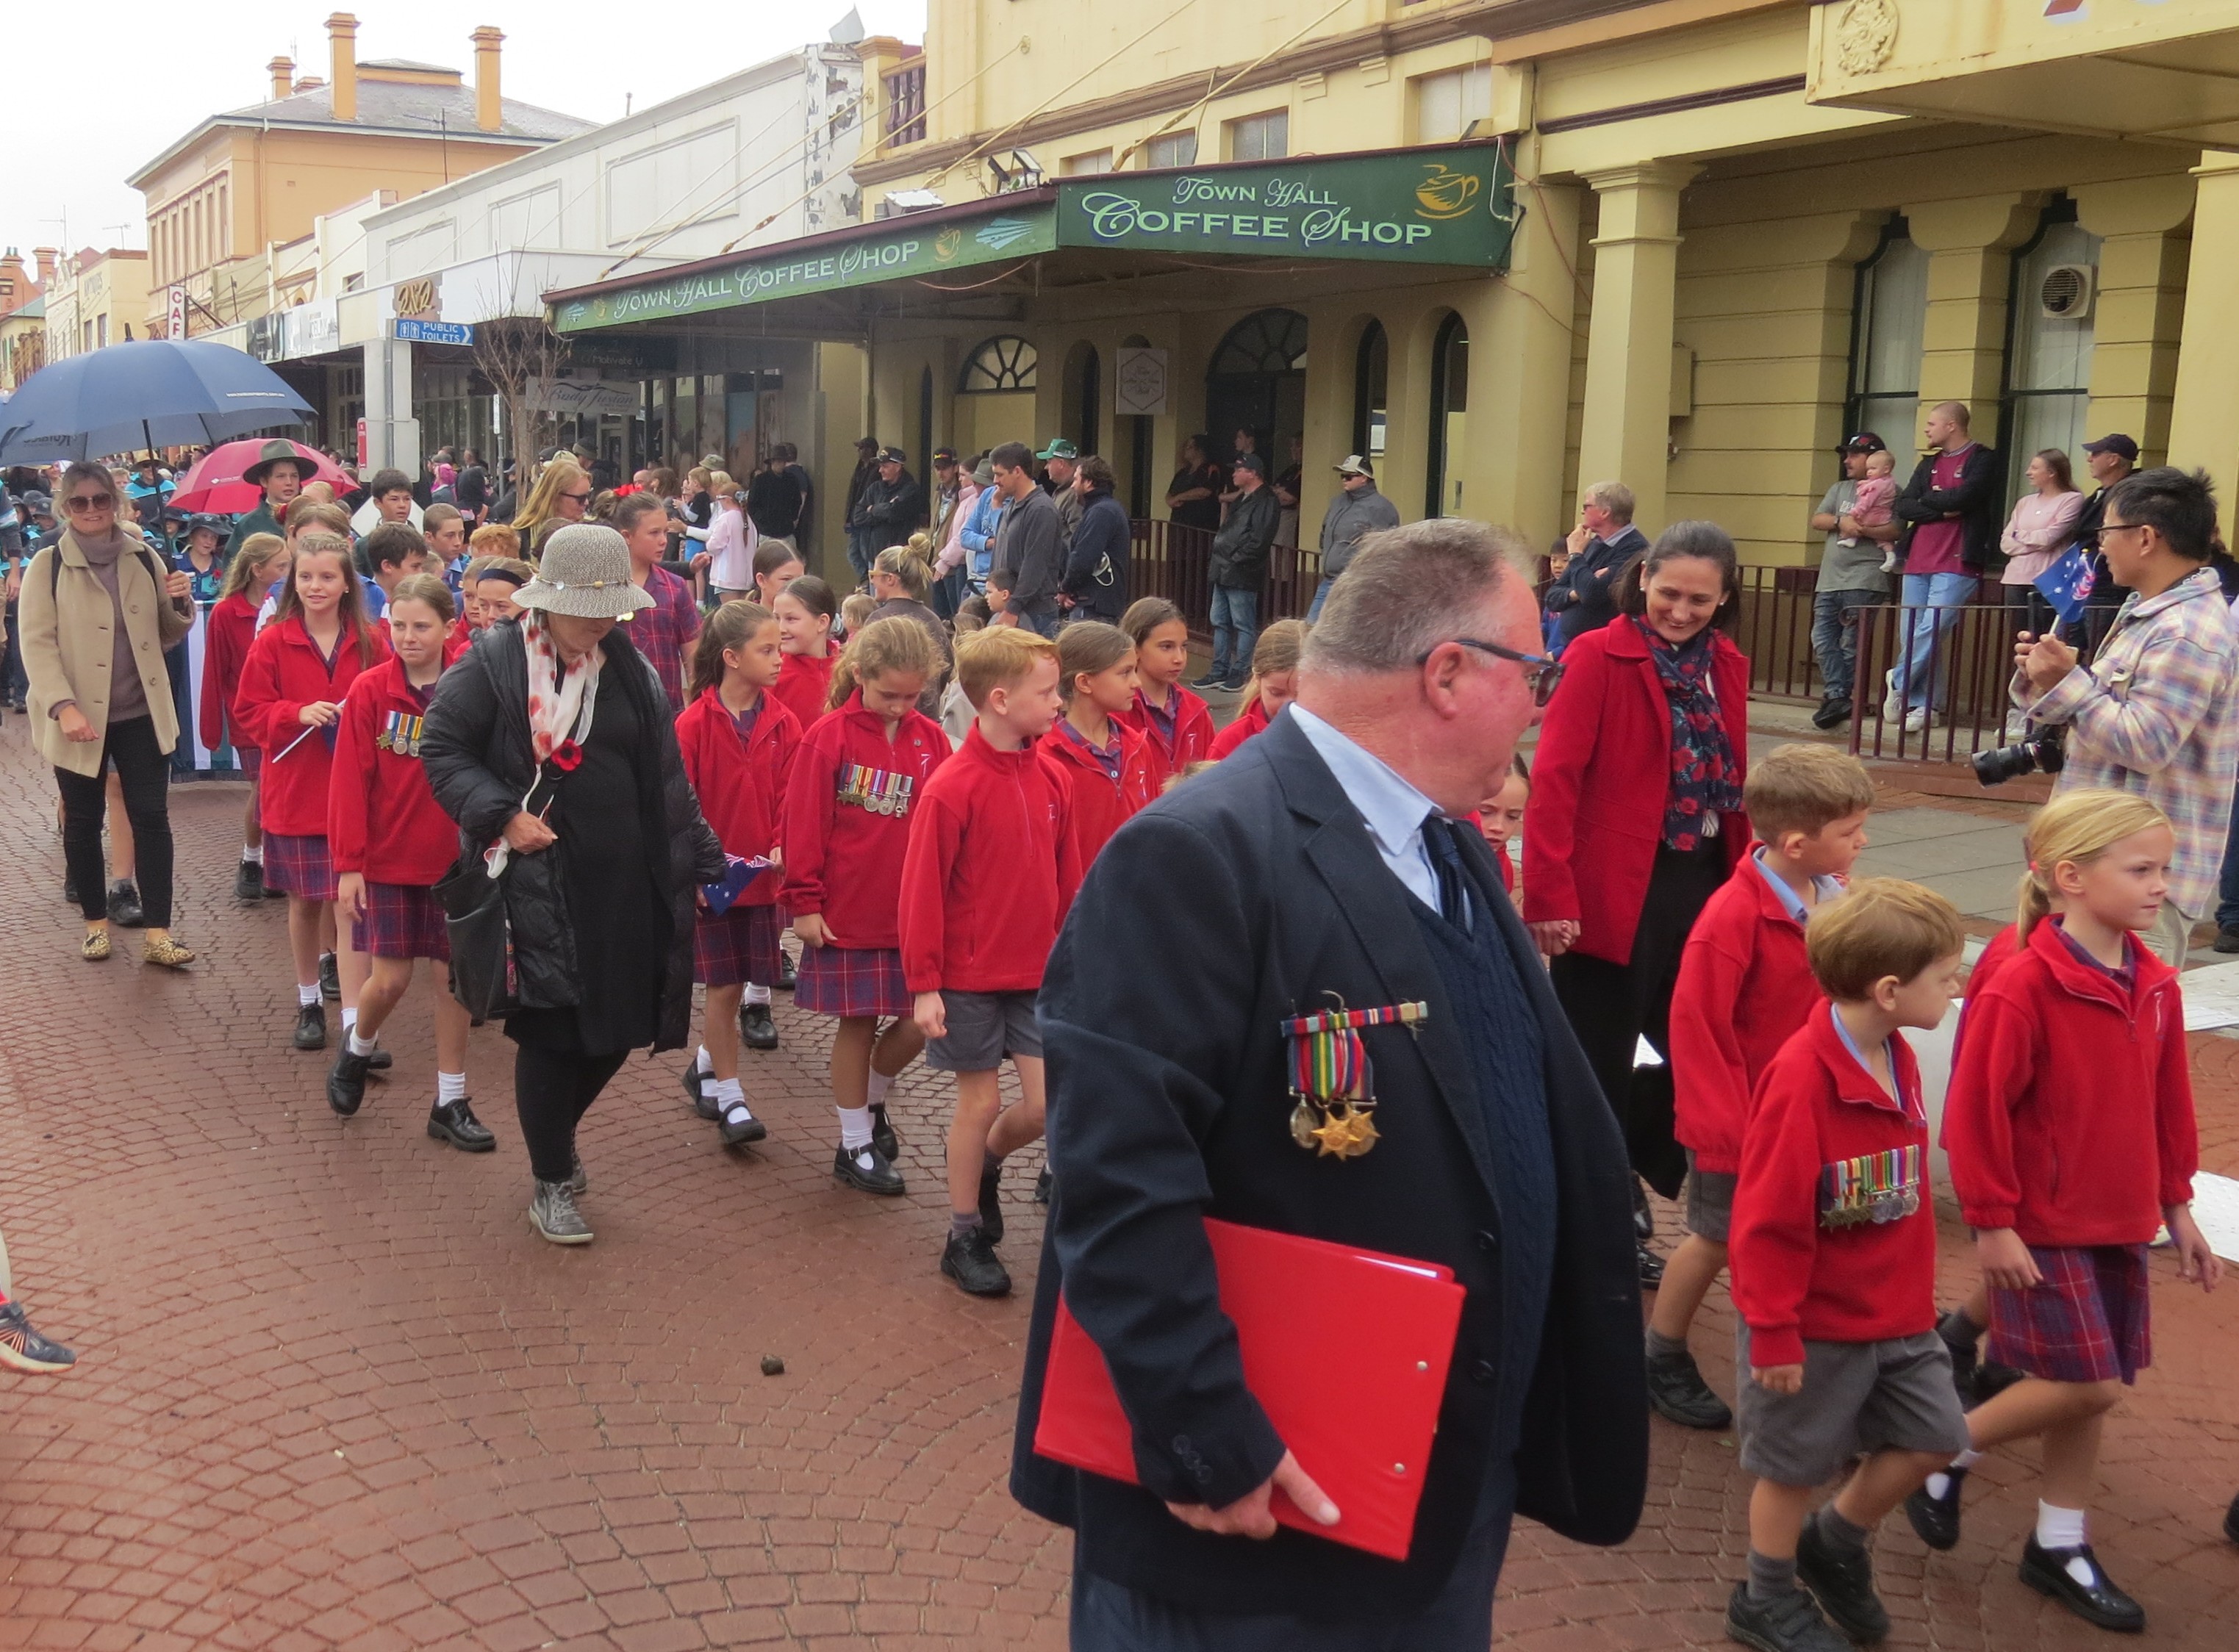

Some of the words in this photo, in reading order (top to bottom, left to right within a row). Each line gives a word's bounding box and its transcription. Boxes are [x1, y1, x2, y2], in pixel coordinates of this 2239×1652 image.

[1172, 176, 1256, 205] TOWN
[1264, 178, 1338, 208] HALL
[1081, 191, 1290, 239] COFFEE
[1300, 206, 1433, 248] SHOP
[613, 290, 671, 320] TOWN
[672, 277, 733, 309] HALL
[734, 259, 836, 298] COFFEE
[839, 240, 920, 281] SHOP
[171, 290, 182, 340] CAF
[423, 322, 459, 333] PUBLIC
[421, 331, 460, 342] TOILETS
